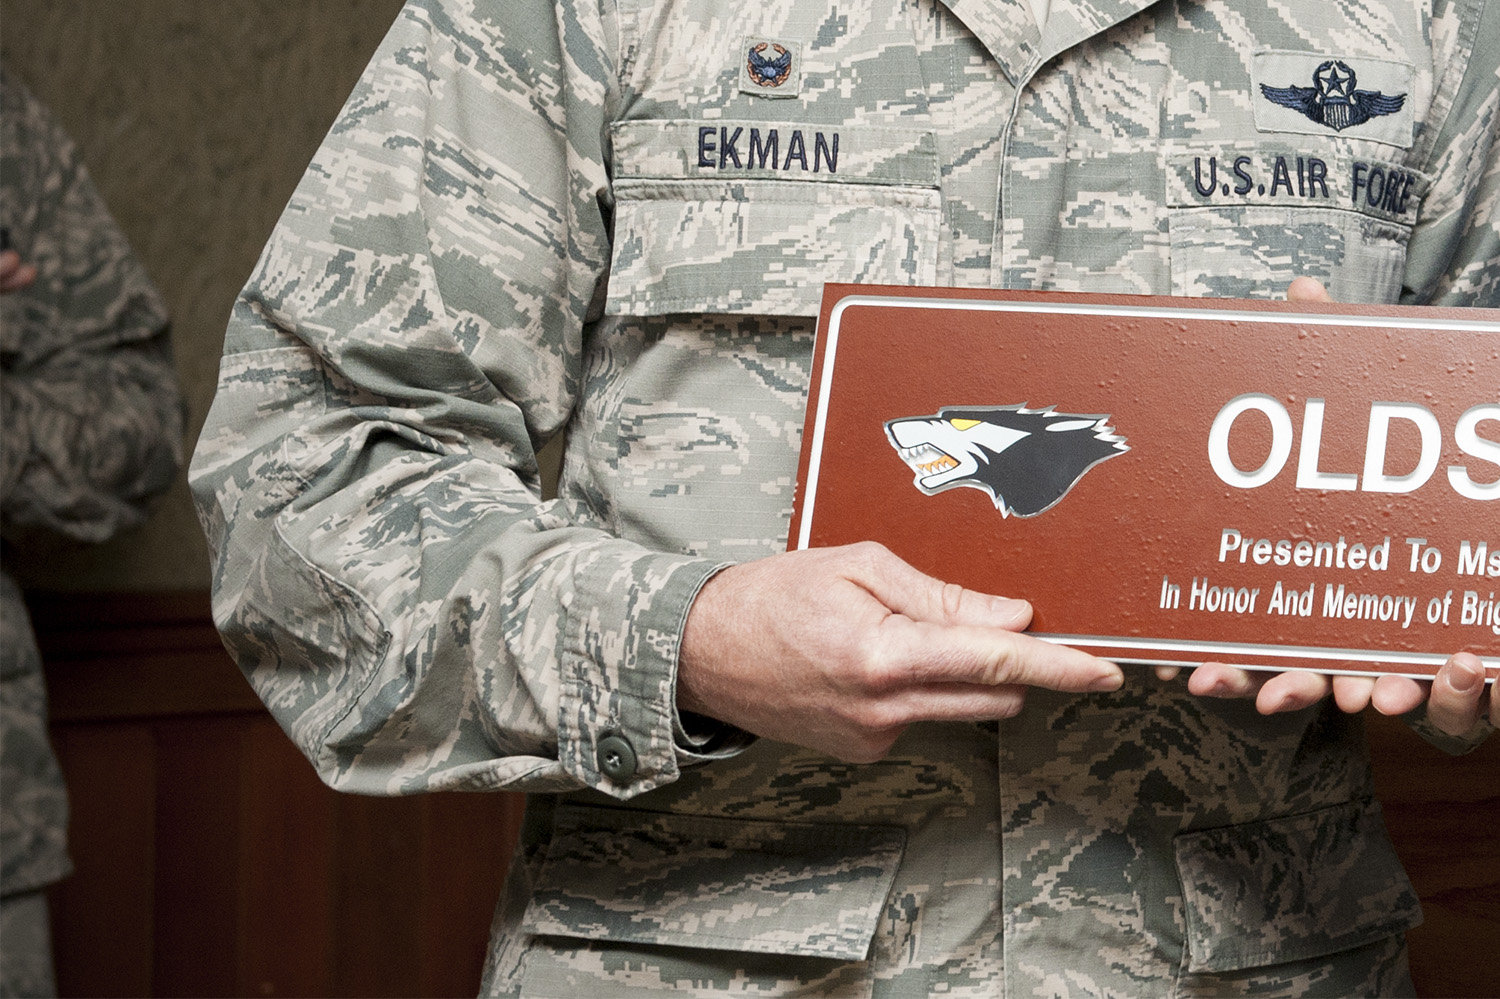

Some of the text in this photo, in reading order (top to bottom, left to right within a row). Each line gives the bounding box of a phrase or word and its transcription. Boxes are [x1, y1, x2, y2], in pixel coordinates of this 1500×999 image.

[698, 126, 839, 173] EKMAN
[1352, 161, 1415, 214] FORCE
[1218, 528, 1390, 571] Presented
[1406, 537, 1441, 574] To
[1160, 575, 1180, 609] In
[1189, 577, 1260, 614] Honor
[1267, 581, 1315, 617] And
[1322, 583, 1417, 629] Memory
[1426, 590, 1452, 624] of
